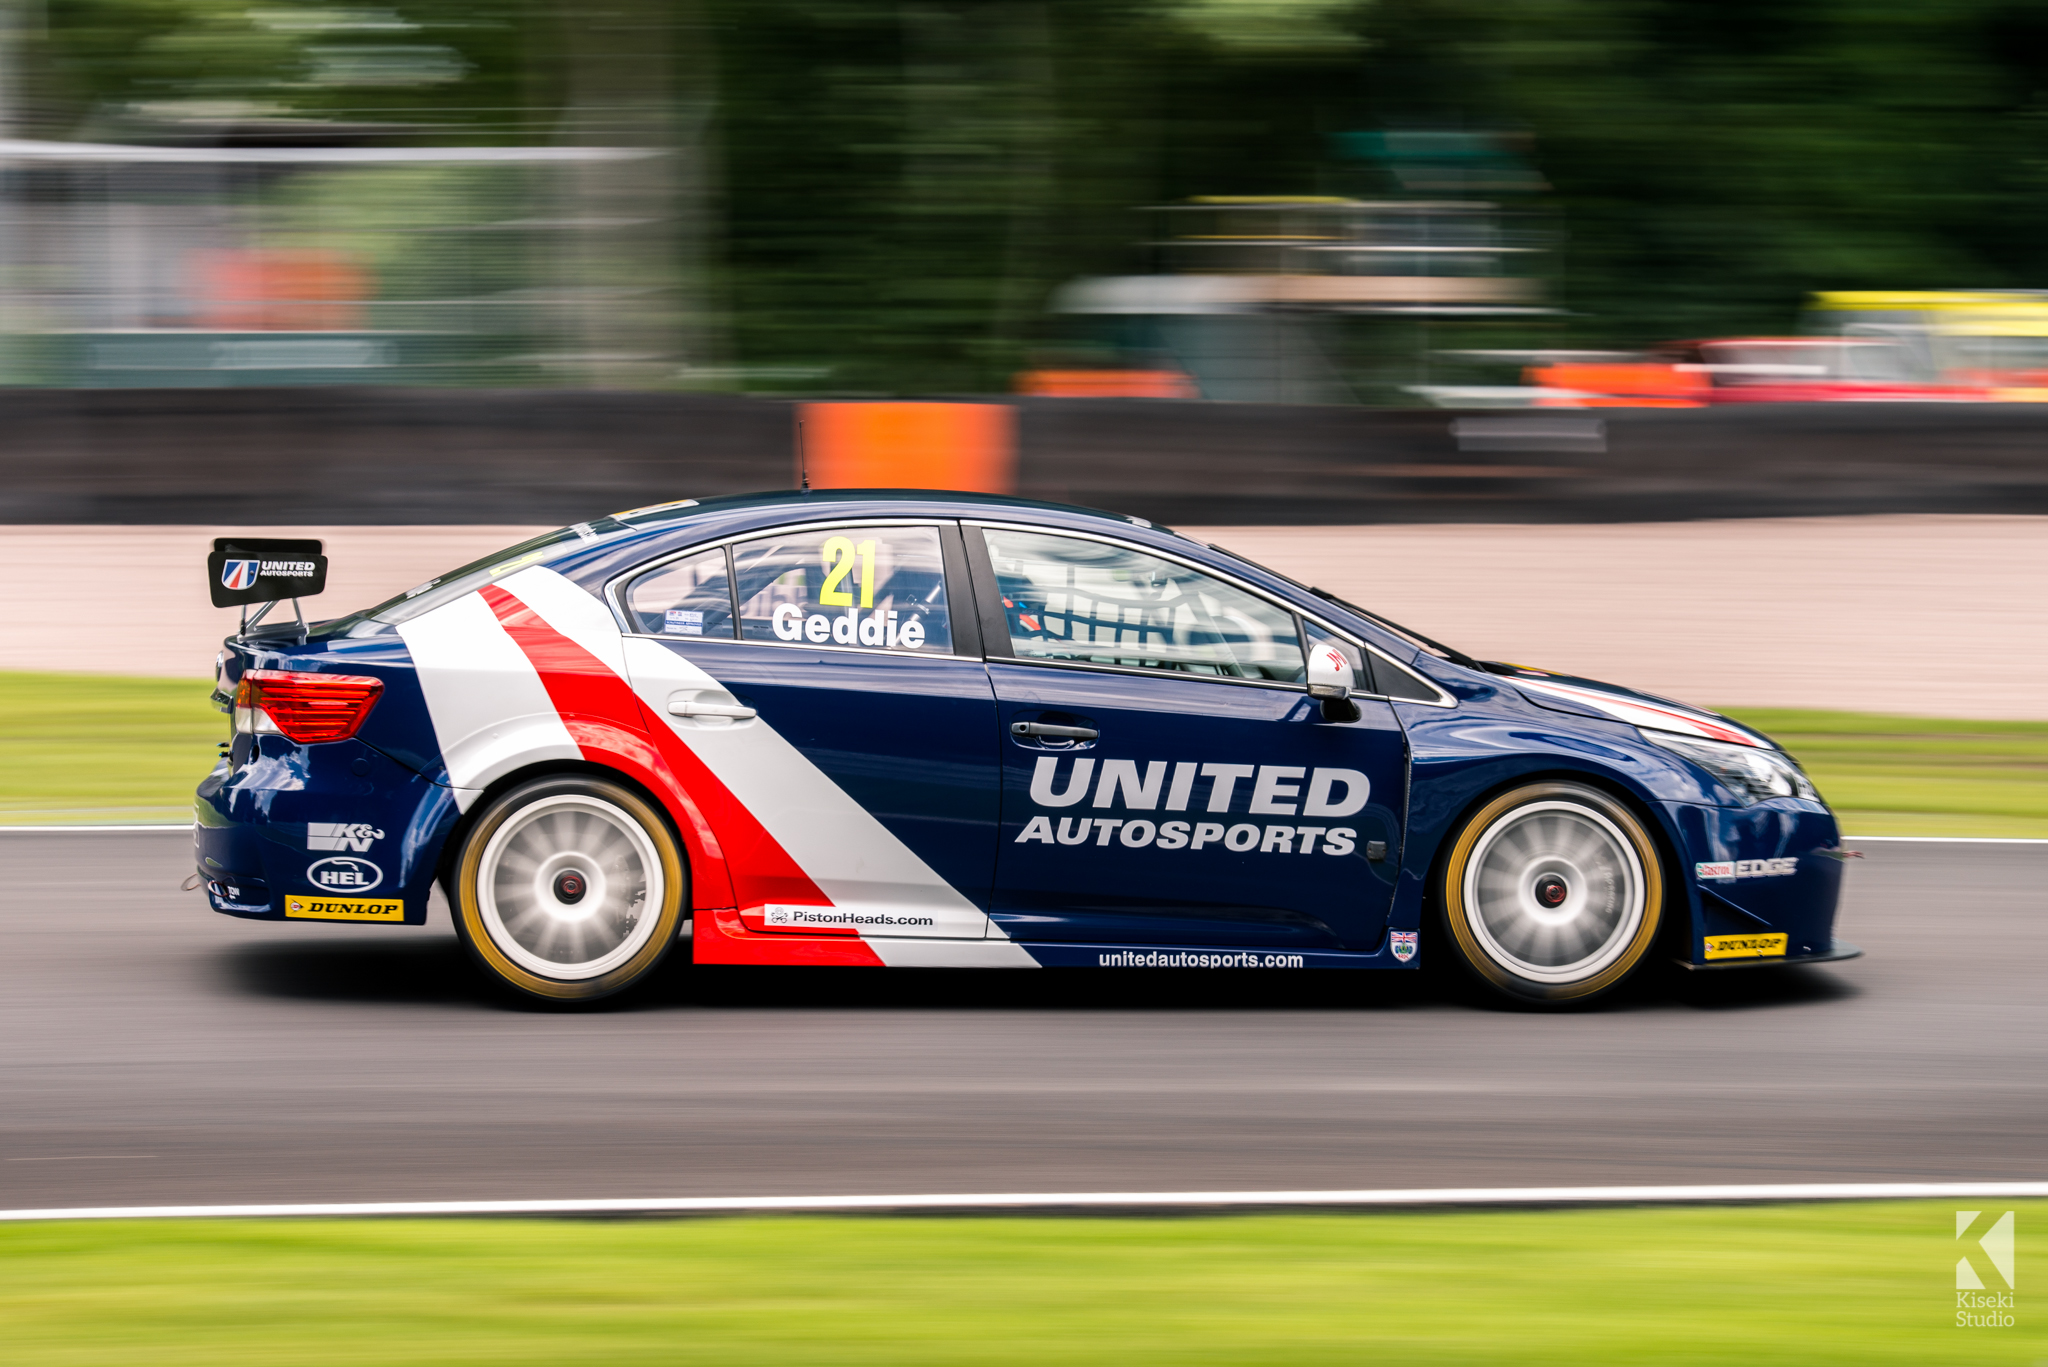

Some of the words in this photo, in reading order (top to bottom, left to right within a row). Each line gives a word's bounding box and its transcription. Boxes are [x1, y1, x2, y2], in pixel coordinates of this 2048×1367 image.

[261, 561, 315, 571] UNITED
[819, 536, 876, 608] 21
[772, 603, 925, 648] Geddie
[1030, 756, 1370, 817] UNITED
[307, 822, 385, 852] K&N
[1014, 815, 1357, 856] AUTOSPORTS
[1736, 857, 1799, 878] EDGE
[320, 870, 370, 885] HEL
[308, 902, 398, 915] DUNLOP
[793, 911, 933, 926] PistonHeads.com
[1716, 938, 1782, 951] DUNLOP
[1099, 951, 1303, 969] unitedautosports.com
